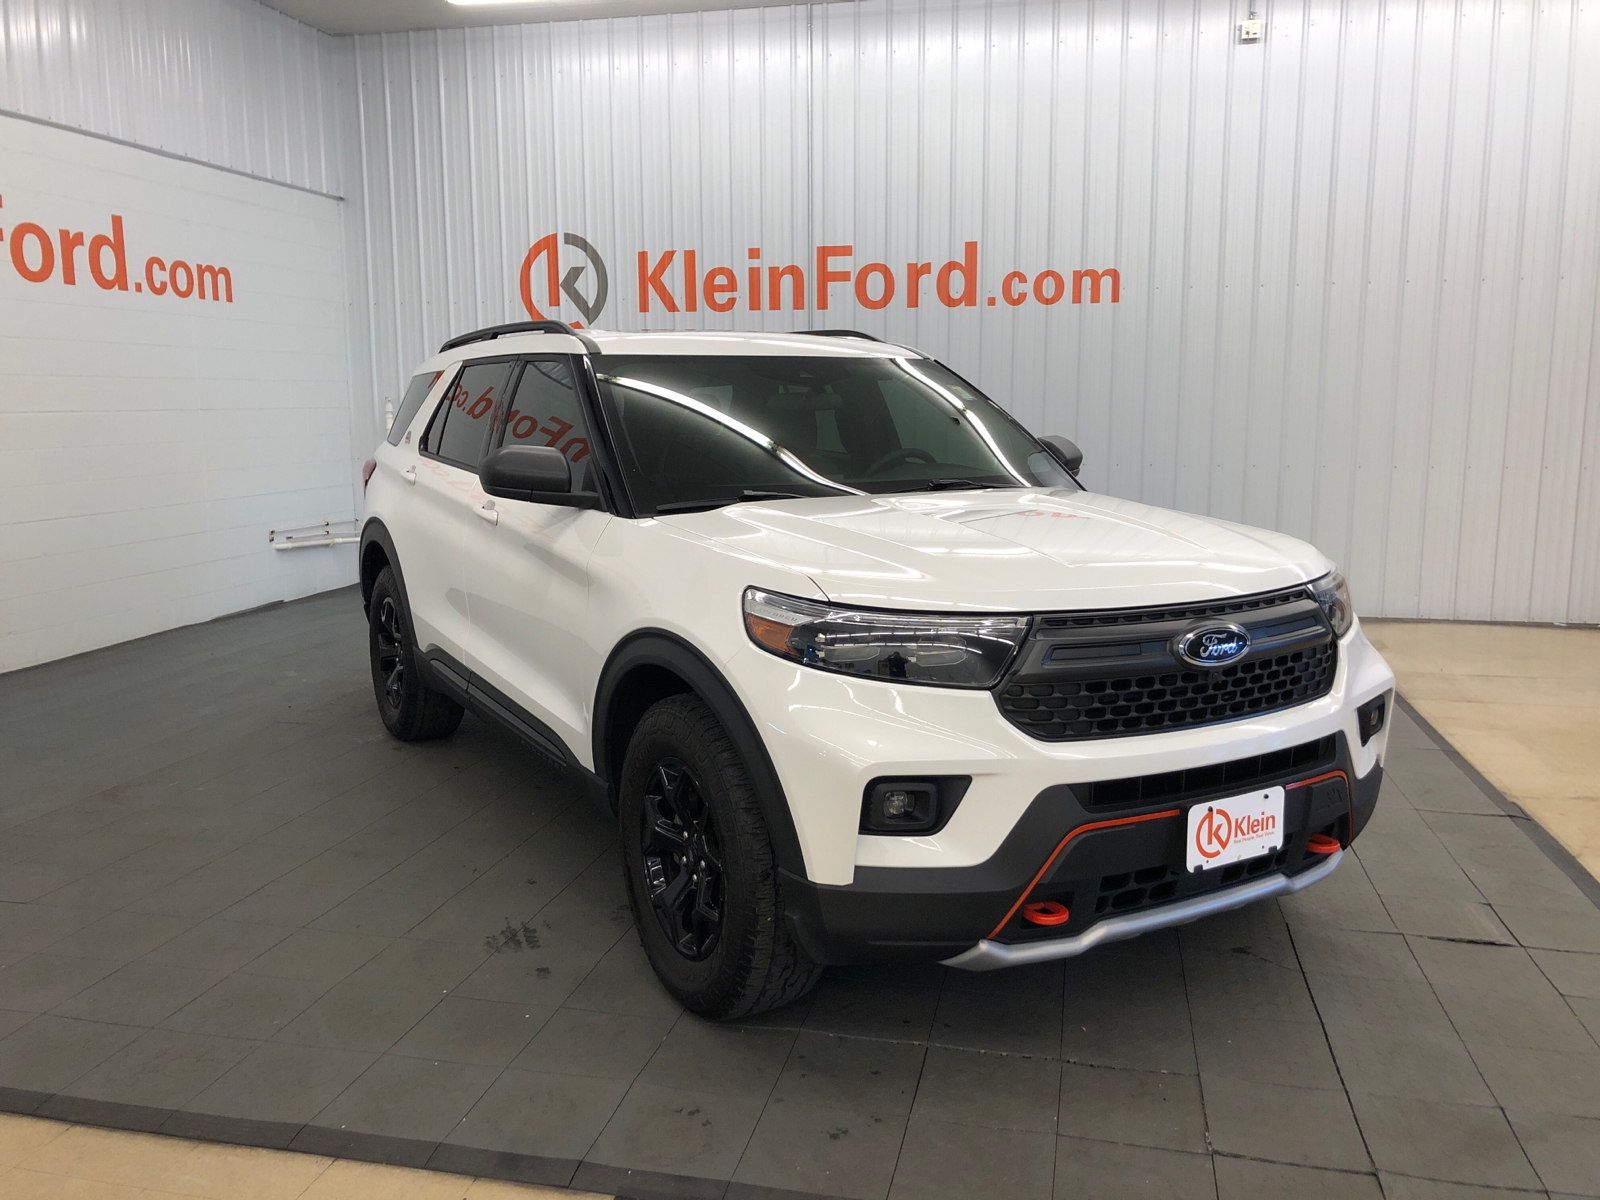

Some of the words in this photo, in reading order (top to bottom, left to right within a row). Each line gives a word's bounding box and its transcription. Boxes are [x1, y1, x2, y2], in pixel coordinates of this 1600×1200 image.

[0, 194, 233, 303] ord.com
[638, 241, 1120, 313] KleinFord.com
[1200, 633, 1238, 658] Ford
[1234, 811, 1276, 838] Klein
